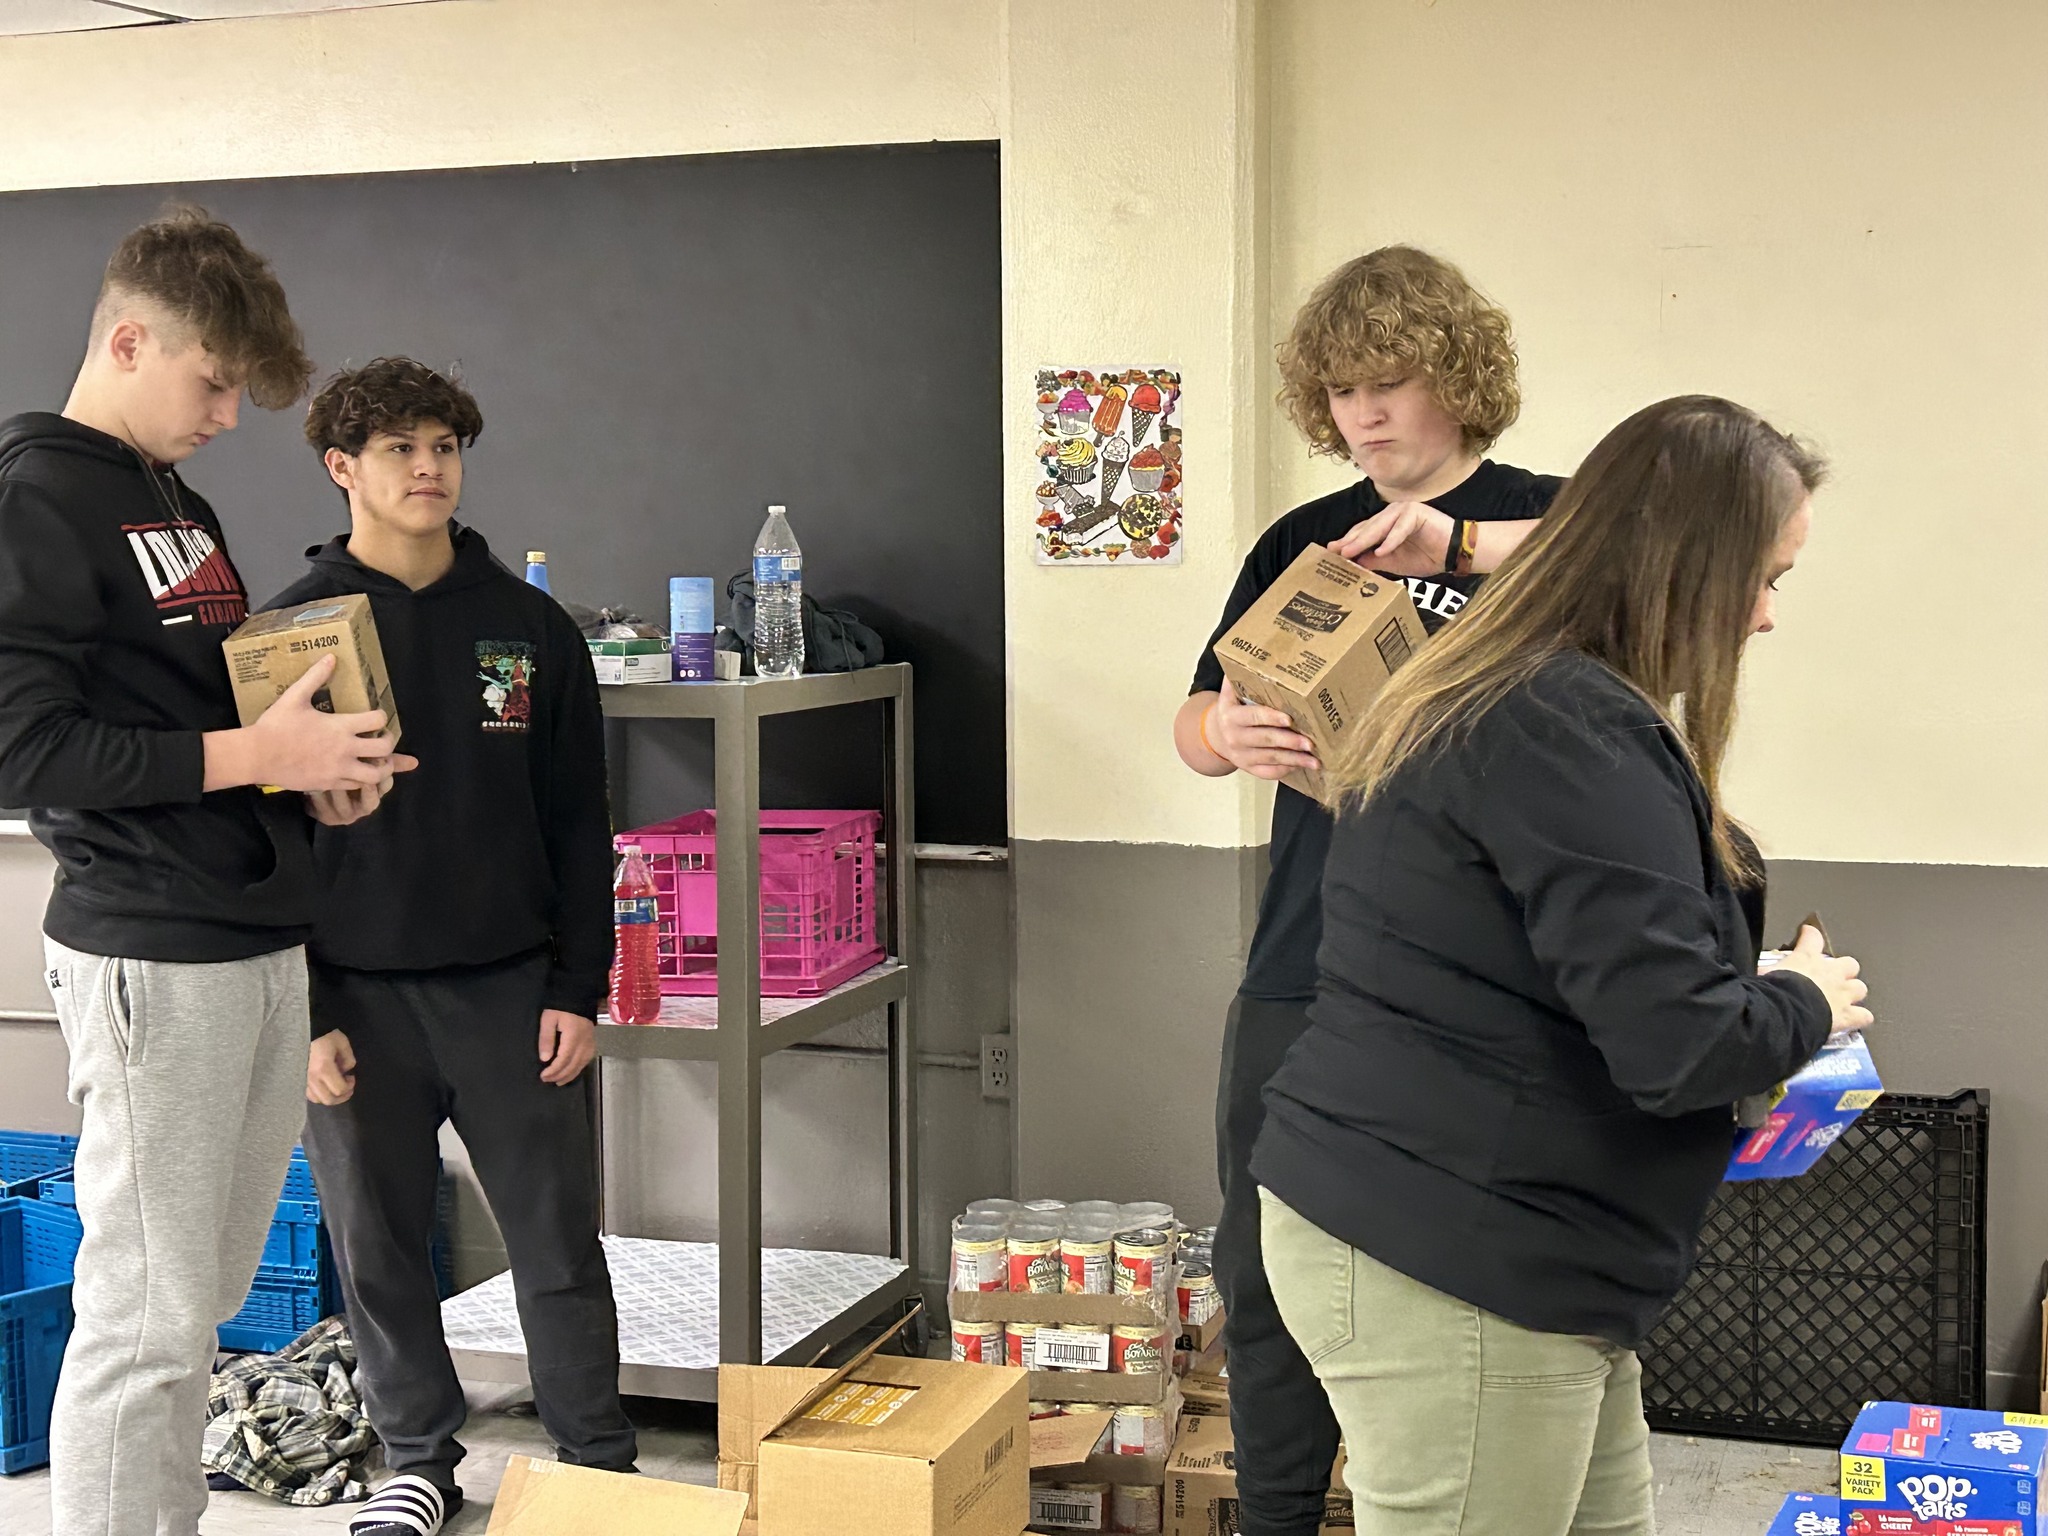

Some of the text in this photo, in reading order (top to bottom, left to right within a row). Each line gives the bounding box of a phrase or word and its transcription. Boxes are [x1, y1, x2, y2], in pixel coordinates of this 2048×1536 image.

[302, 635, 339, 652] 514200
[1231, 637, 1263, 660] 514200
[1318, 687, 1339, 723] 514200
[1853, 1462, 1873, 1473] 32
[1846, 1477, 1881, 1488] VARIETY
[1852, 1486, 1875, 1496] PACK
[1912, 1499, 1968, 1520] tarts
